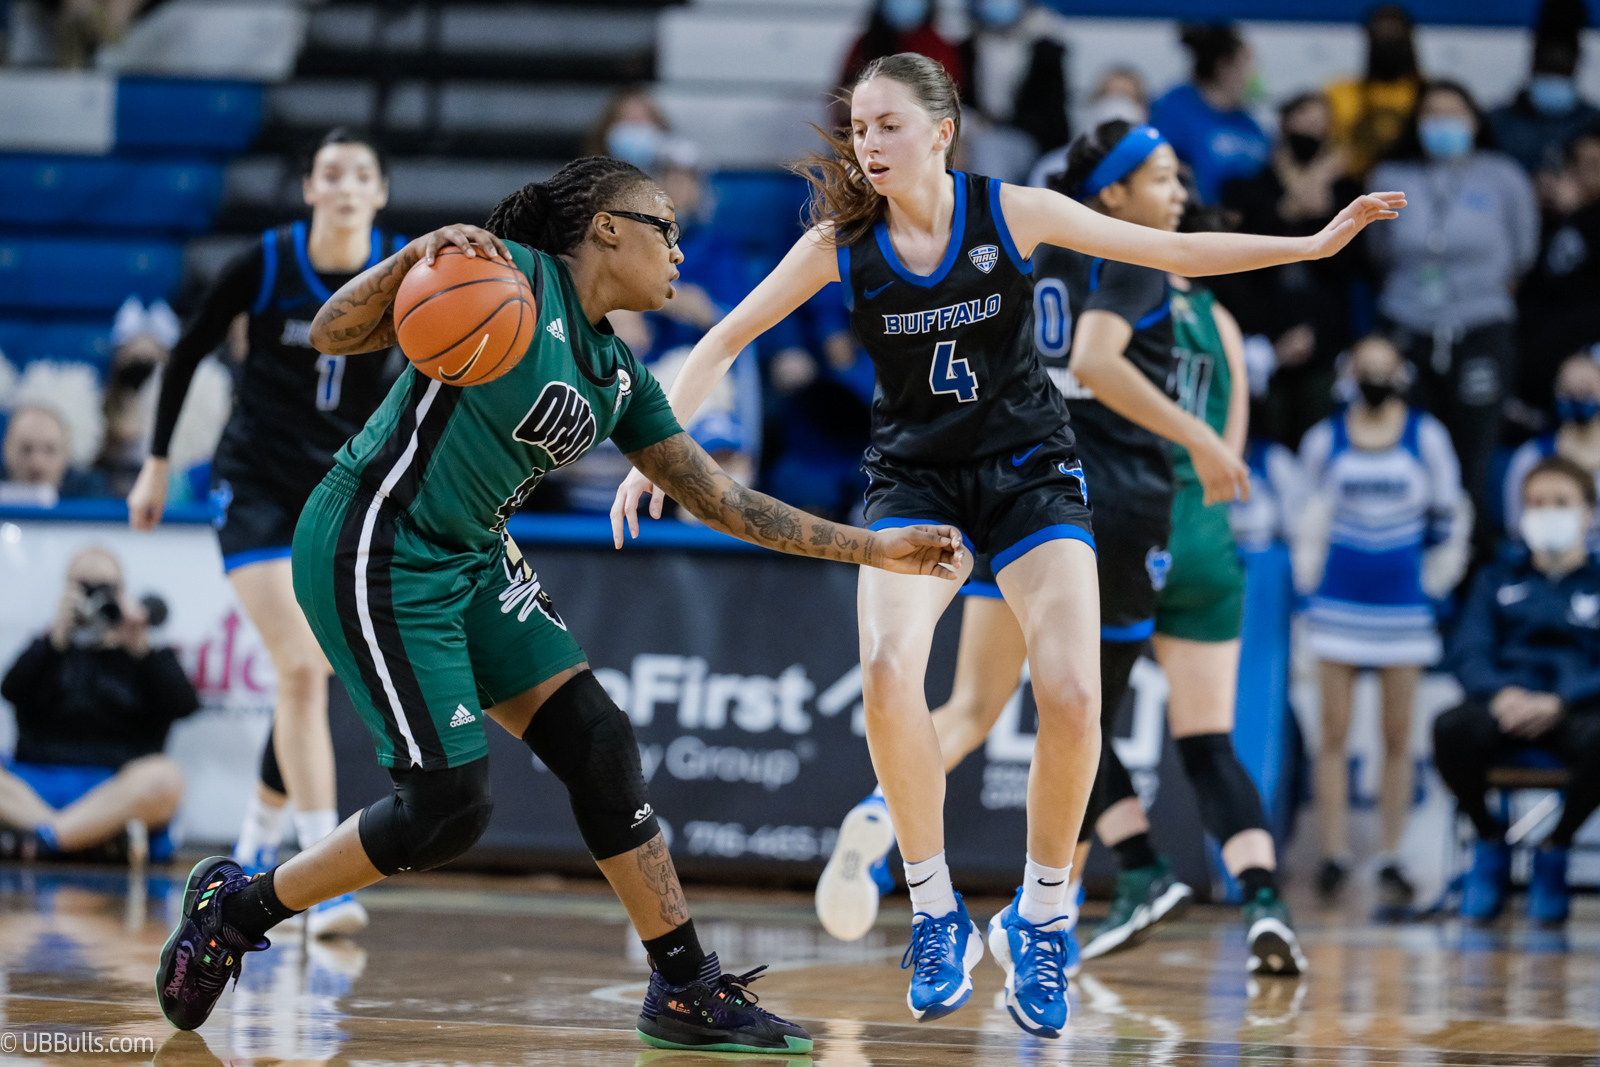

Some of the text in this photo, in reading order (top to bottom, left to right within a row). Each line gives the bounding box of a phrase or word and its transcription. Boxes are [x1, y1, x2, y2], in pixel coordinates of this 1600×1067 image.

[972, 252, 998, 265] MAC
[882, 293, 1001, 335] BUFFALO
[314, 354, 347, 411] 1
[929, 340, 979, 403] 4
[511, 380, 597, 472] OHIO
[449, 714, 476, 728] adidas
[664, 735, 800, 790] Group
